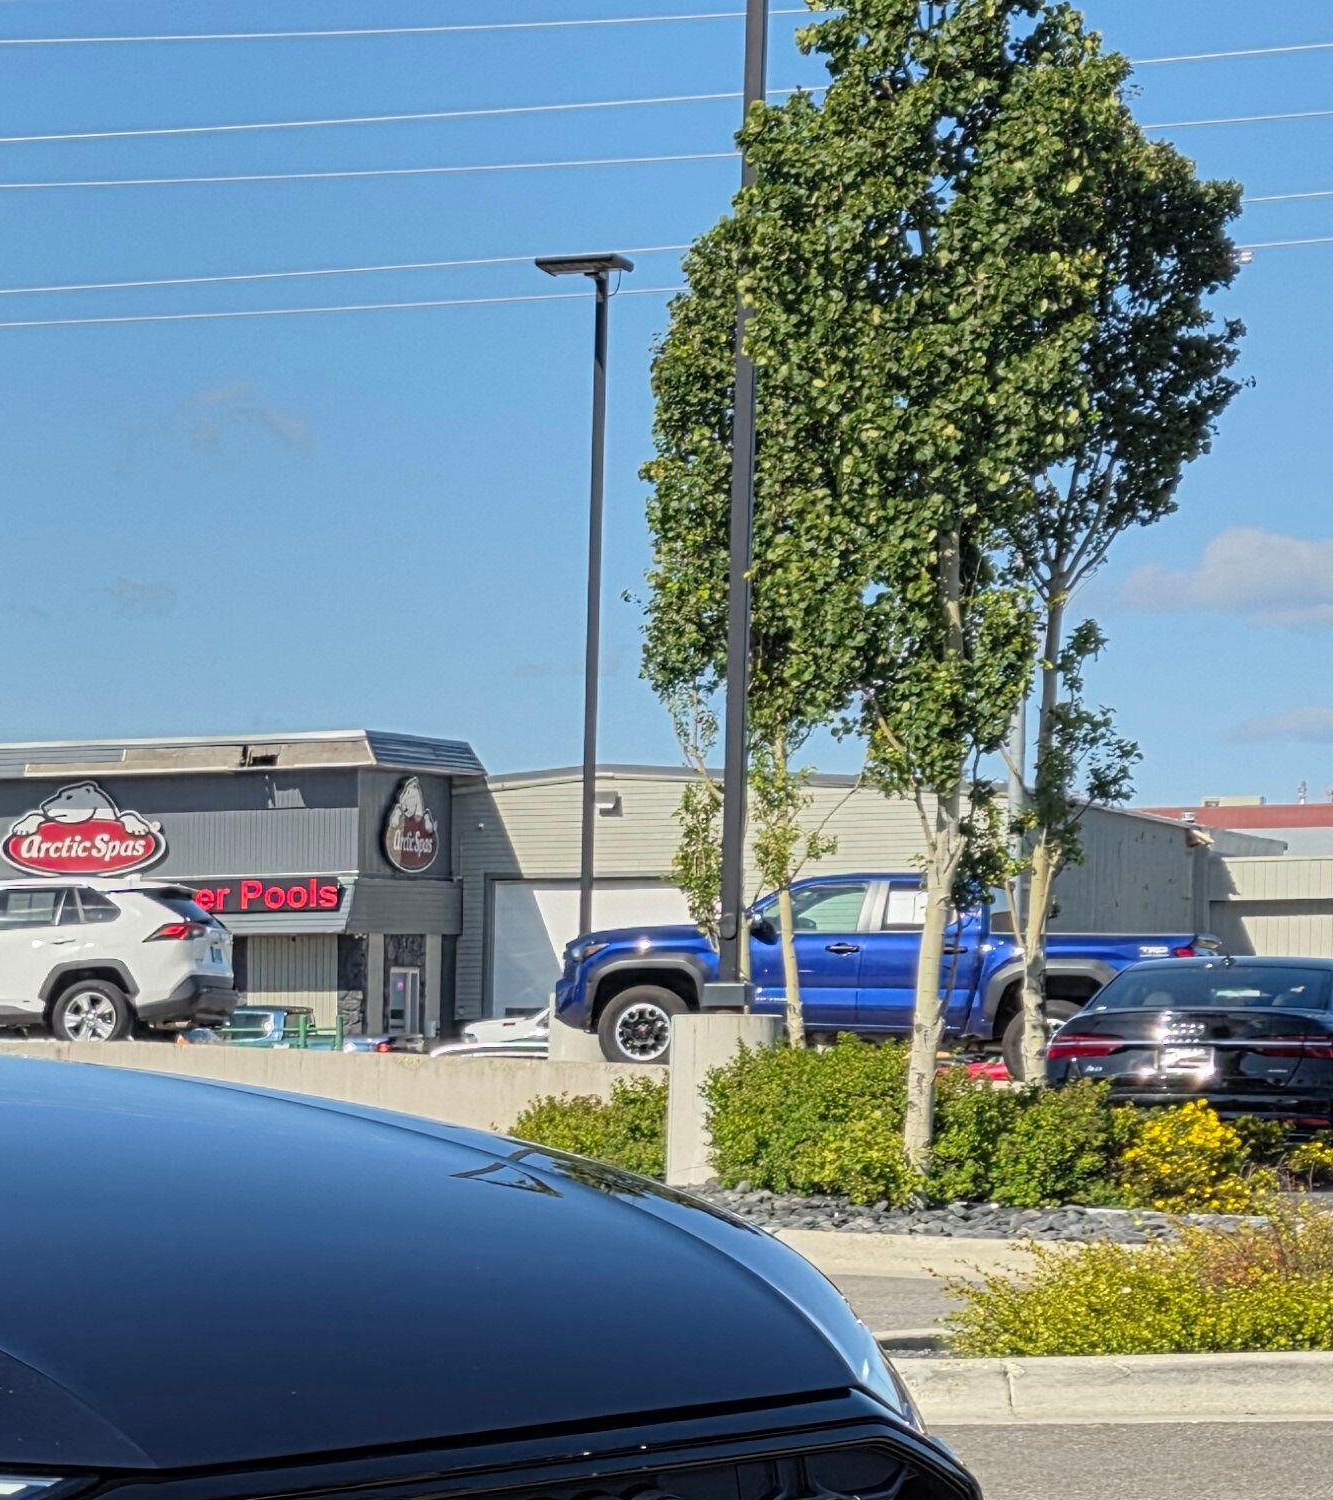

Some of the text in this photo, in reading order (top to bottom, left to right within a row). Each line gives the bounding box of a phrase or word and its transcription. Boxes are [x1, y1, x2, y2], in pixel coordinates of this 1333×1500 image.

[20, 834, 146, 861] Arctic Spas
[241, 876, 338, 909] Pools
